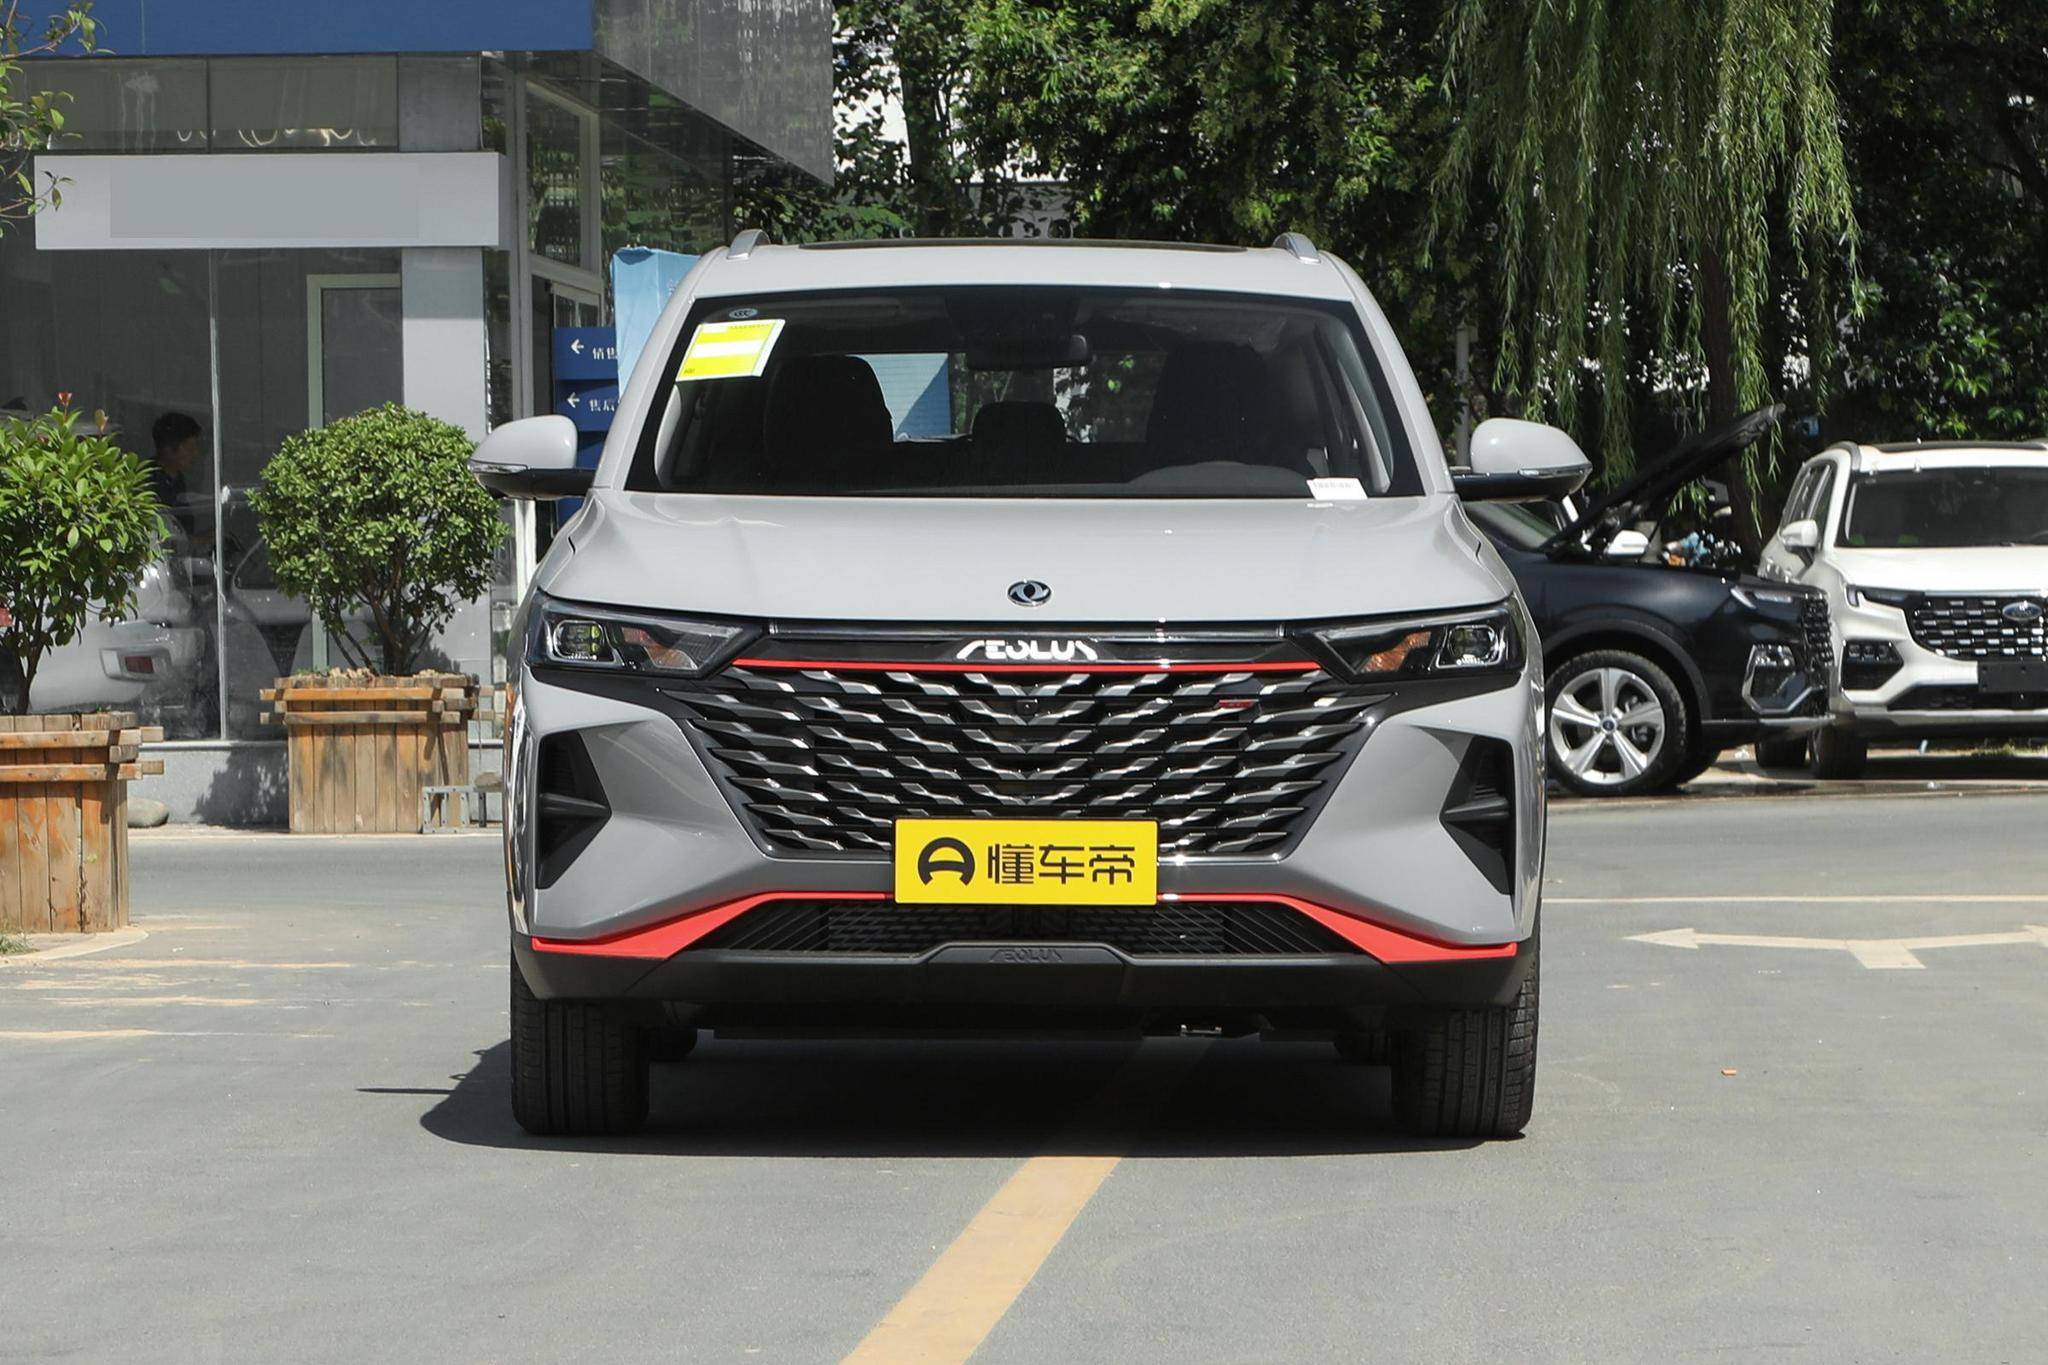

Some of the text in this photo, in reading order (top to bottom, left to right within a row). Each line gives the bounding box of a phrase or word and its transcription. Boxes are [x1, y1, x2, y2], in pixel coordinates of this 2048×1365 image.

[956, 640, 1098, 660] AEOLUS
[987, 843, 1135, 885] 懂车帝
